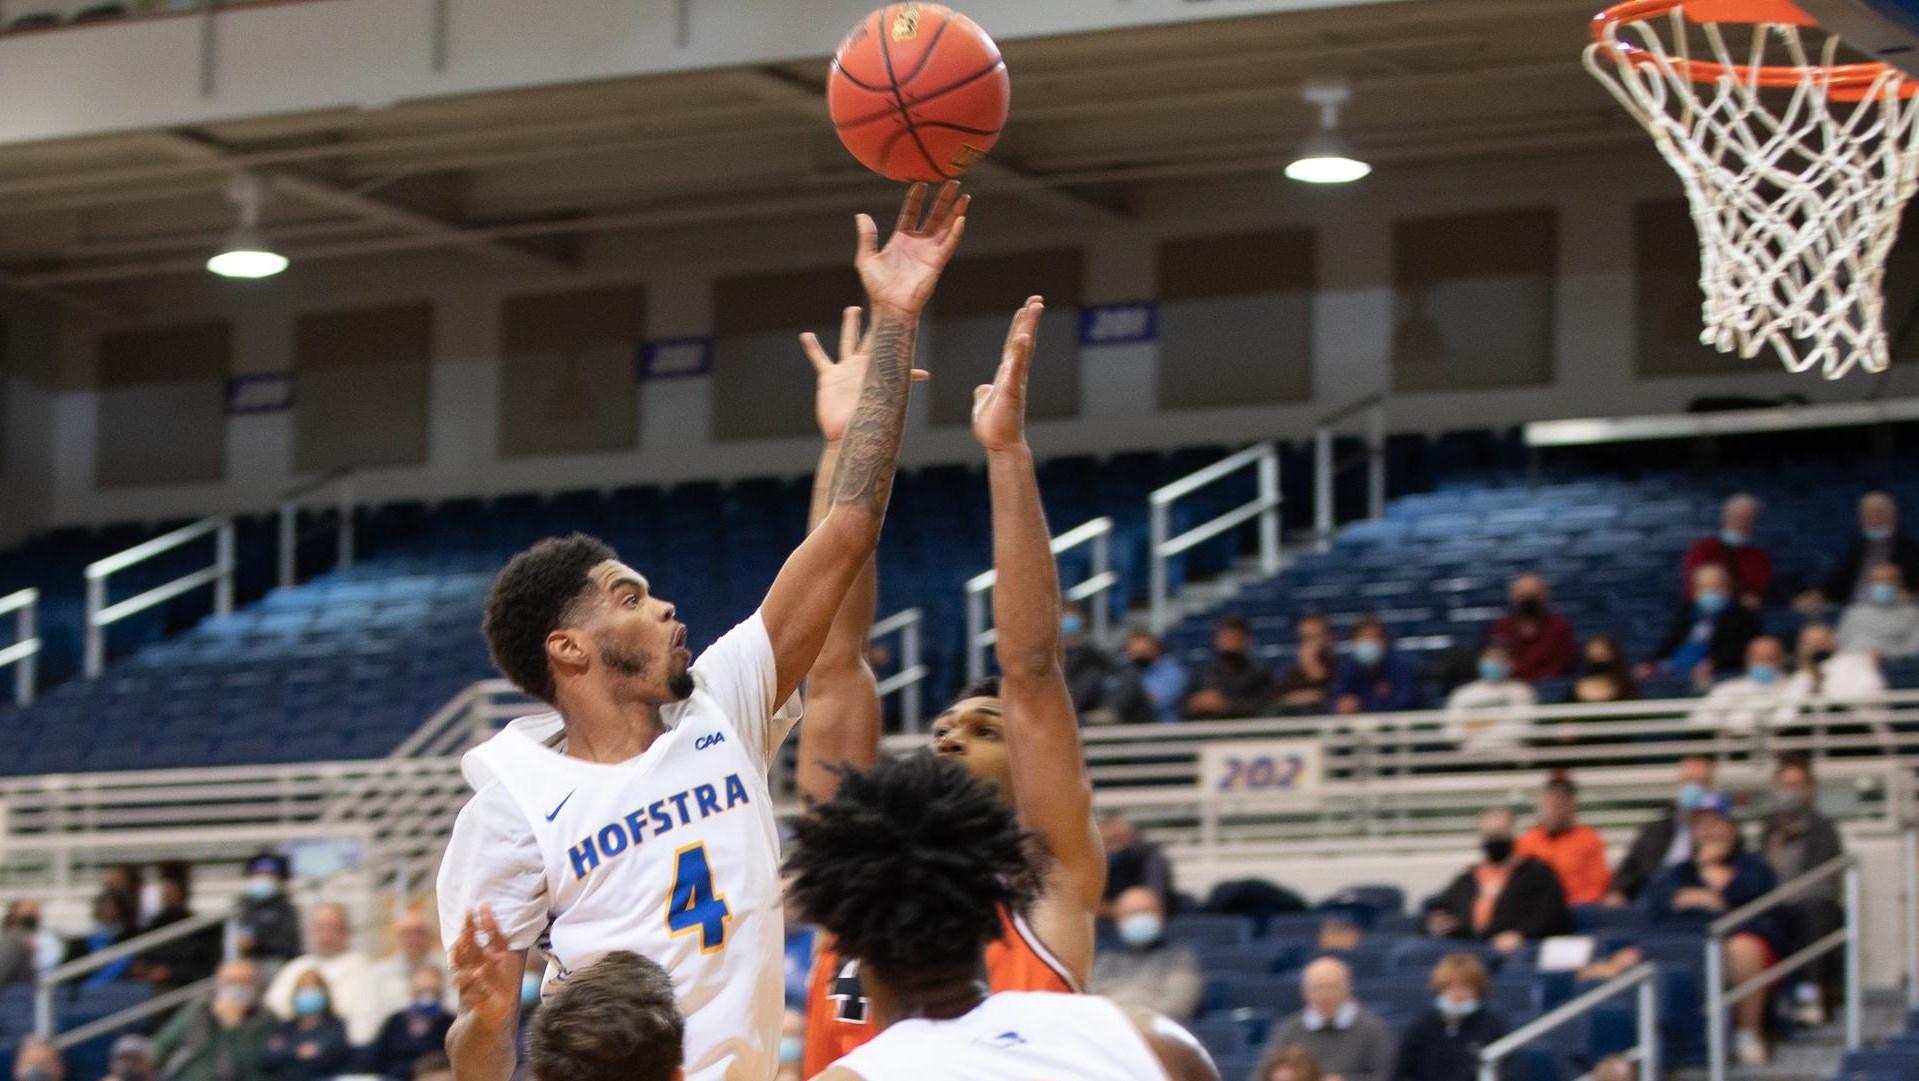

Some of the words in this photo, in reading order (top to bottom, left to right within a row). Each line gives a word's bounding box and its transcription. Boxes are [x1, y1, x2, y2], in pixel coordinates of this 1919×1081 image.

[695, 731, 725, 751] CAA
[1217, 754, 1304, 791] 202
[567, 773, 750, 882] HOFSTRA
[664, 840, 733, 954] 4
